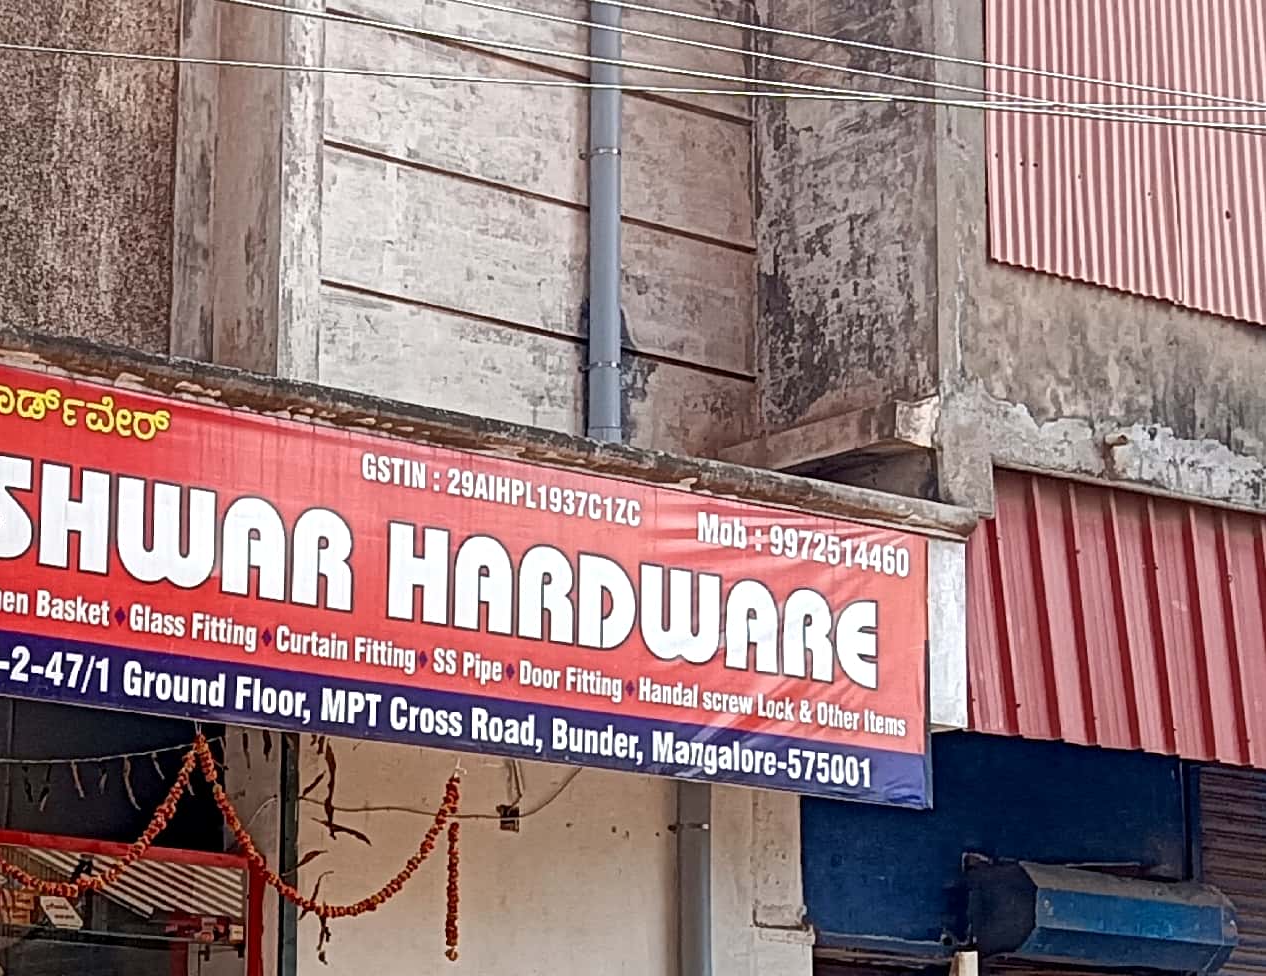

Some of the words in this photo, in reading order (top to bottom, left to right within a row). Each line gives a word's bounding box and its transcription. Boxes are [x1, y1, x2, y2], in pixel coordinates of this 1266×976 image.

[361, 453, 427, 489] GSTIN
[386, 520, 878, 690] HARDWARE
[697, 512, 748, 550] Mob
[770, 525, 911, 577] 9972514460
[36, 589, 111, 627] Basket
[129, 601, 185, 637] Glass
[191, 612, 258, 653] Fitting
[275, 625, 349, 661] Curtain
[354, 635, 417, 674] Fitting
[433, 647, 457, 675] SS
[462, 652, 503, 684] Pipe
[519, 660, 562, 690] Door
[566, 666, 623, 702] Fitting
[638, 677, 698, 709] Handal
[702, 689, 753, 715] screw
[757, 693, 795, 722] Lock
[799, 699, 813, 723] &
[817, 701, 860, 732] Other
[863, 709, 906, 737] Items
[123, 662, 225, 708] Ground
[236, 676, 311, 725] Floor,
[320, 688, 382, 728] MPT
[389, 696, 463, 738] Cross
[471, 708, 543, 754] Road,
[552, 718, 644, 766] Bunder,
[652, 731, 872, 788] Mangalore-575001
